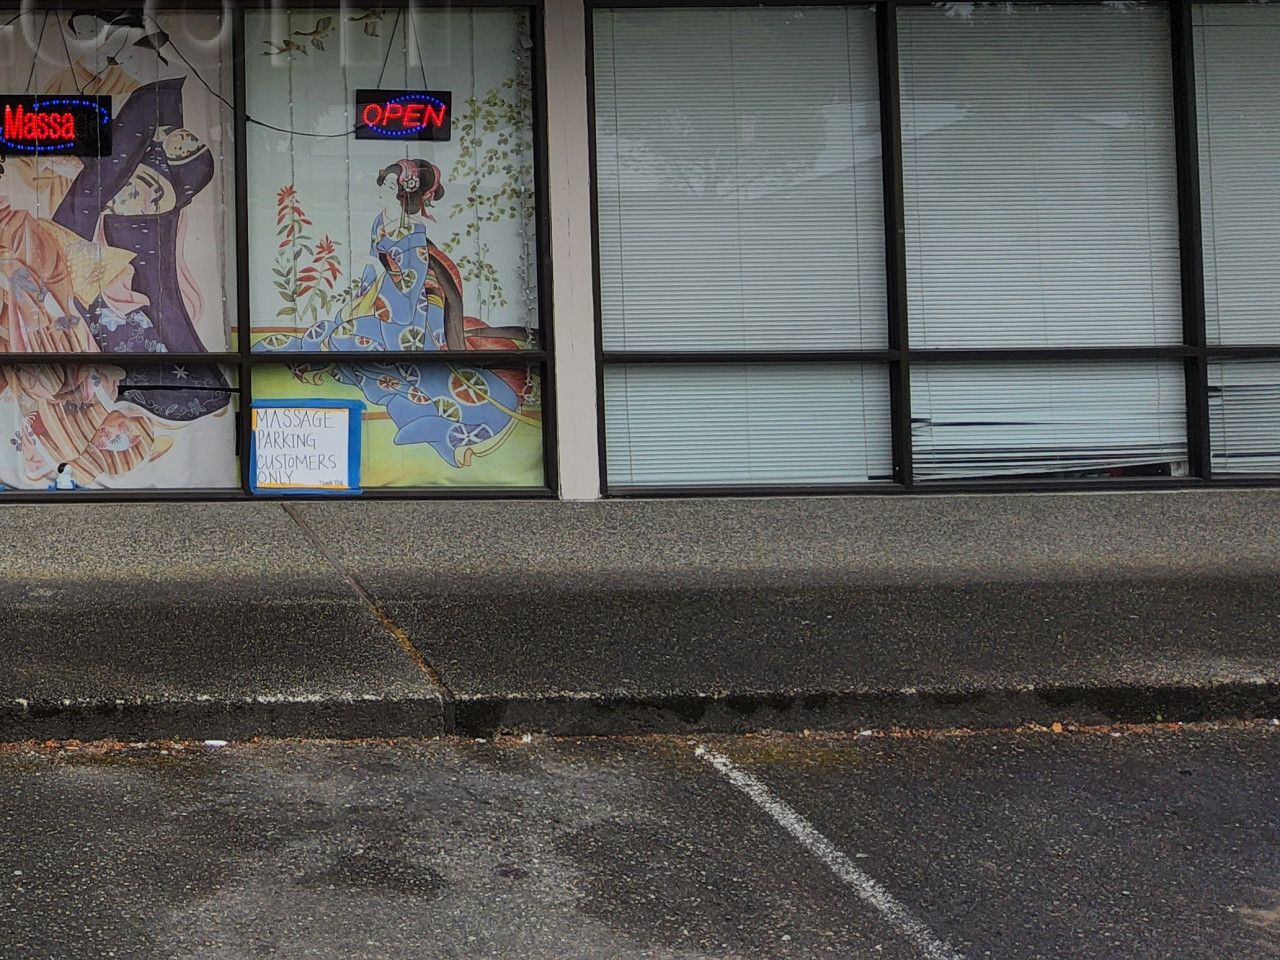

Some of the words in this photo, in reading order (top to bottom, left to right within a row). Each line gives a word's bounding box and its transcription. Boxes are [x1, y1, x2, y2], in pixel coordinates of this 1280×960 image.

[362, 103, 446, 128] OPEN
[256, 409, 336, 429] MASSAGE
[257, 429, 317, 450] PARKING
[256, 453, 337, 471] CUSTOMERS
[257, 470, 294, 484] ONLY
